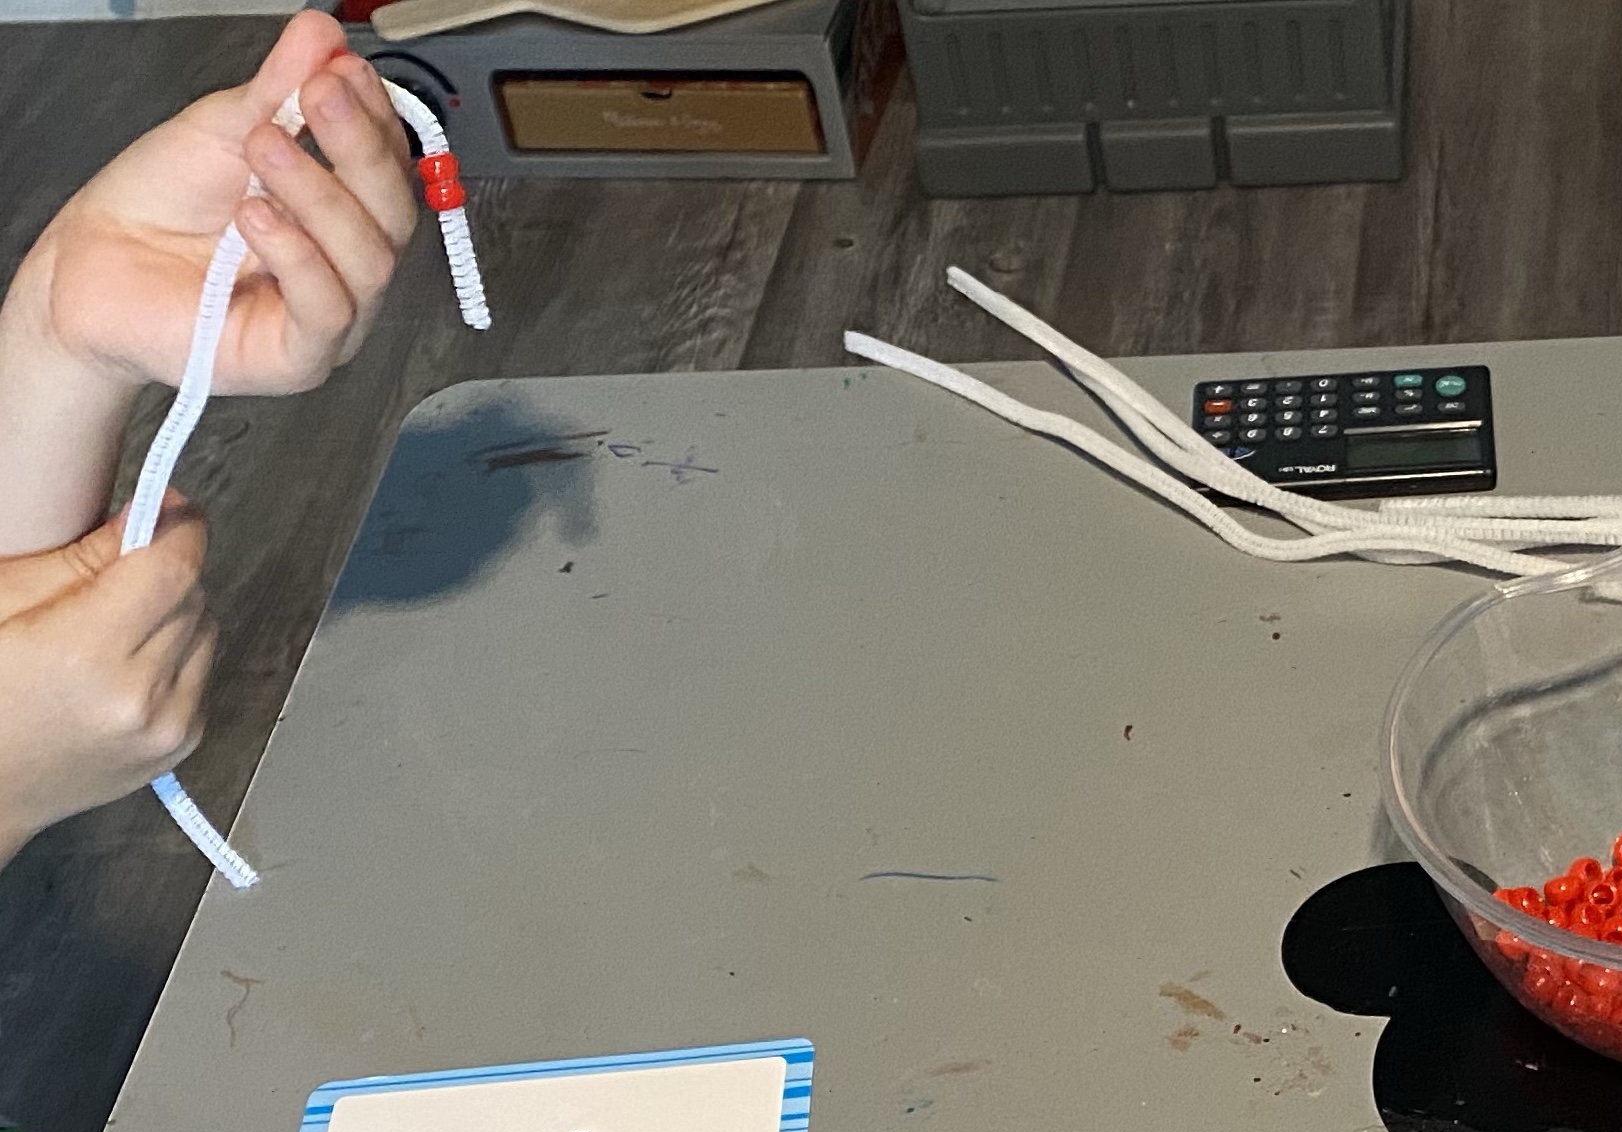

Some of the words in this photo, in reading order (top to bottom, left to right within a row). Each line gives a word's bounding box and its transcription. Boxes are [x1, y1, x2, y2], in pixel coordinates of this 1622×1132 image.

[1319, 379, 1328, 387] 0
[1248, 398, 1258, 406] 3
[1282, 396, 1293, 404] 2
[1320, 394, 1326, 402] 1
[1248, 414, 1258, 422] 6
[1247, 429, 1257, 438] 9
[1319, 425, 1328, 434] 7
[1294, 464, 1336, 473] ROYAL
